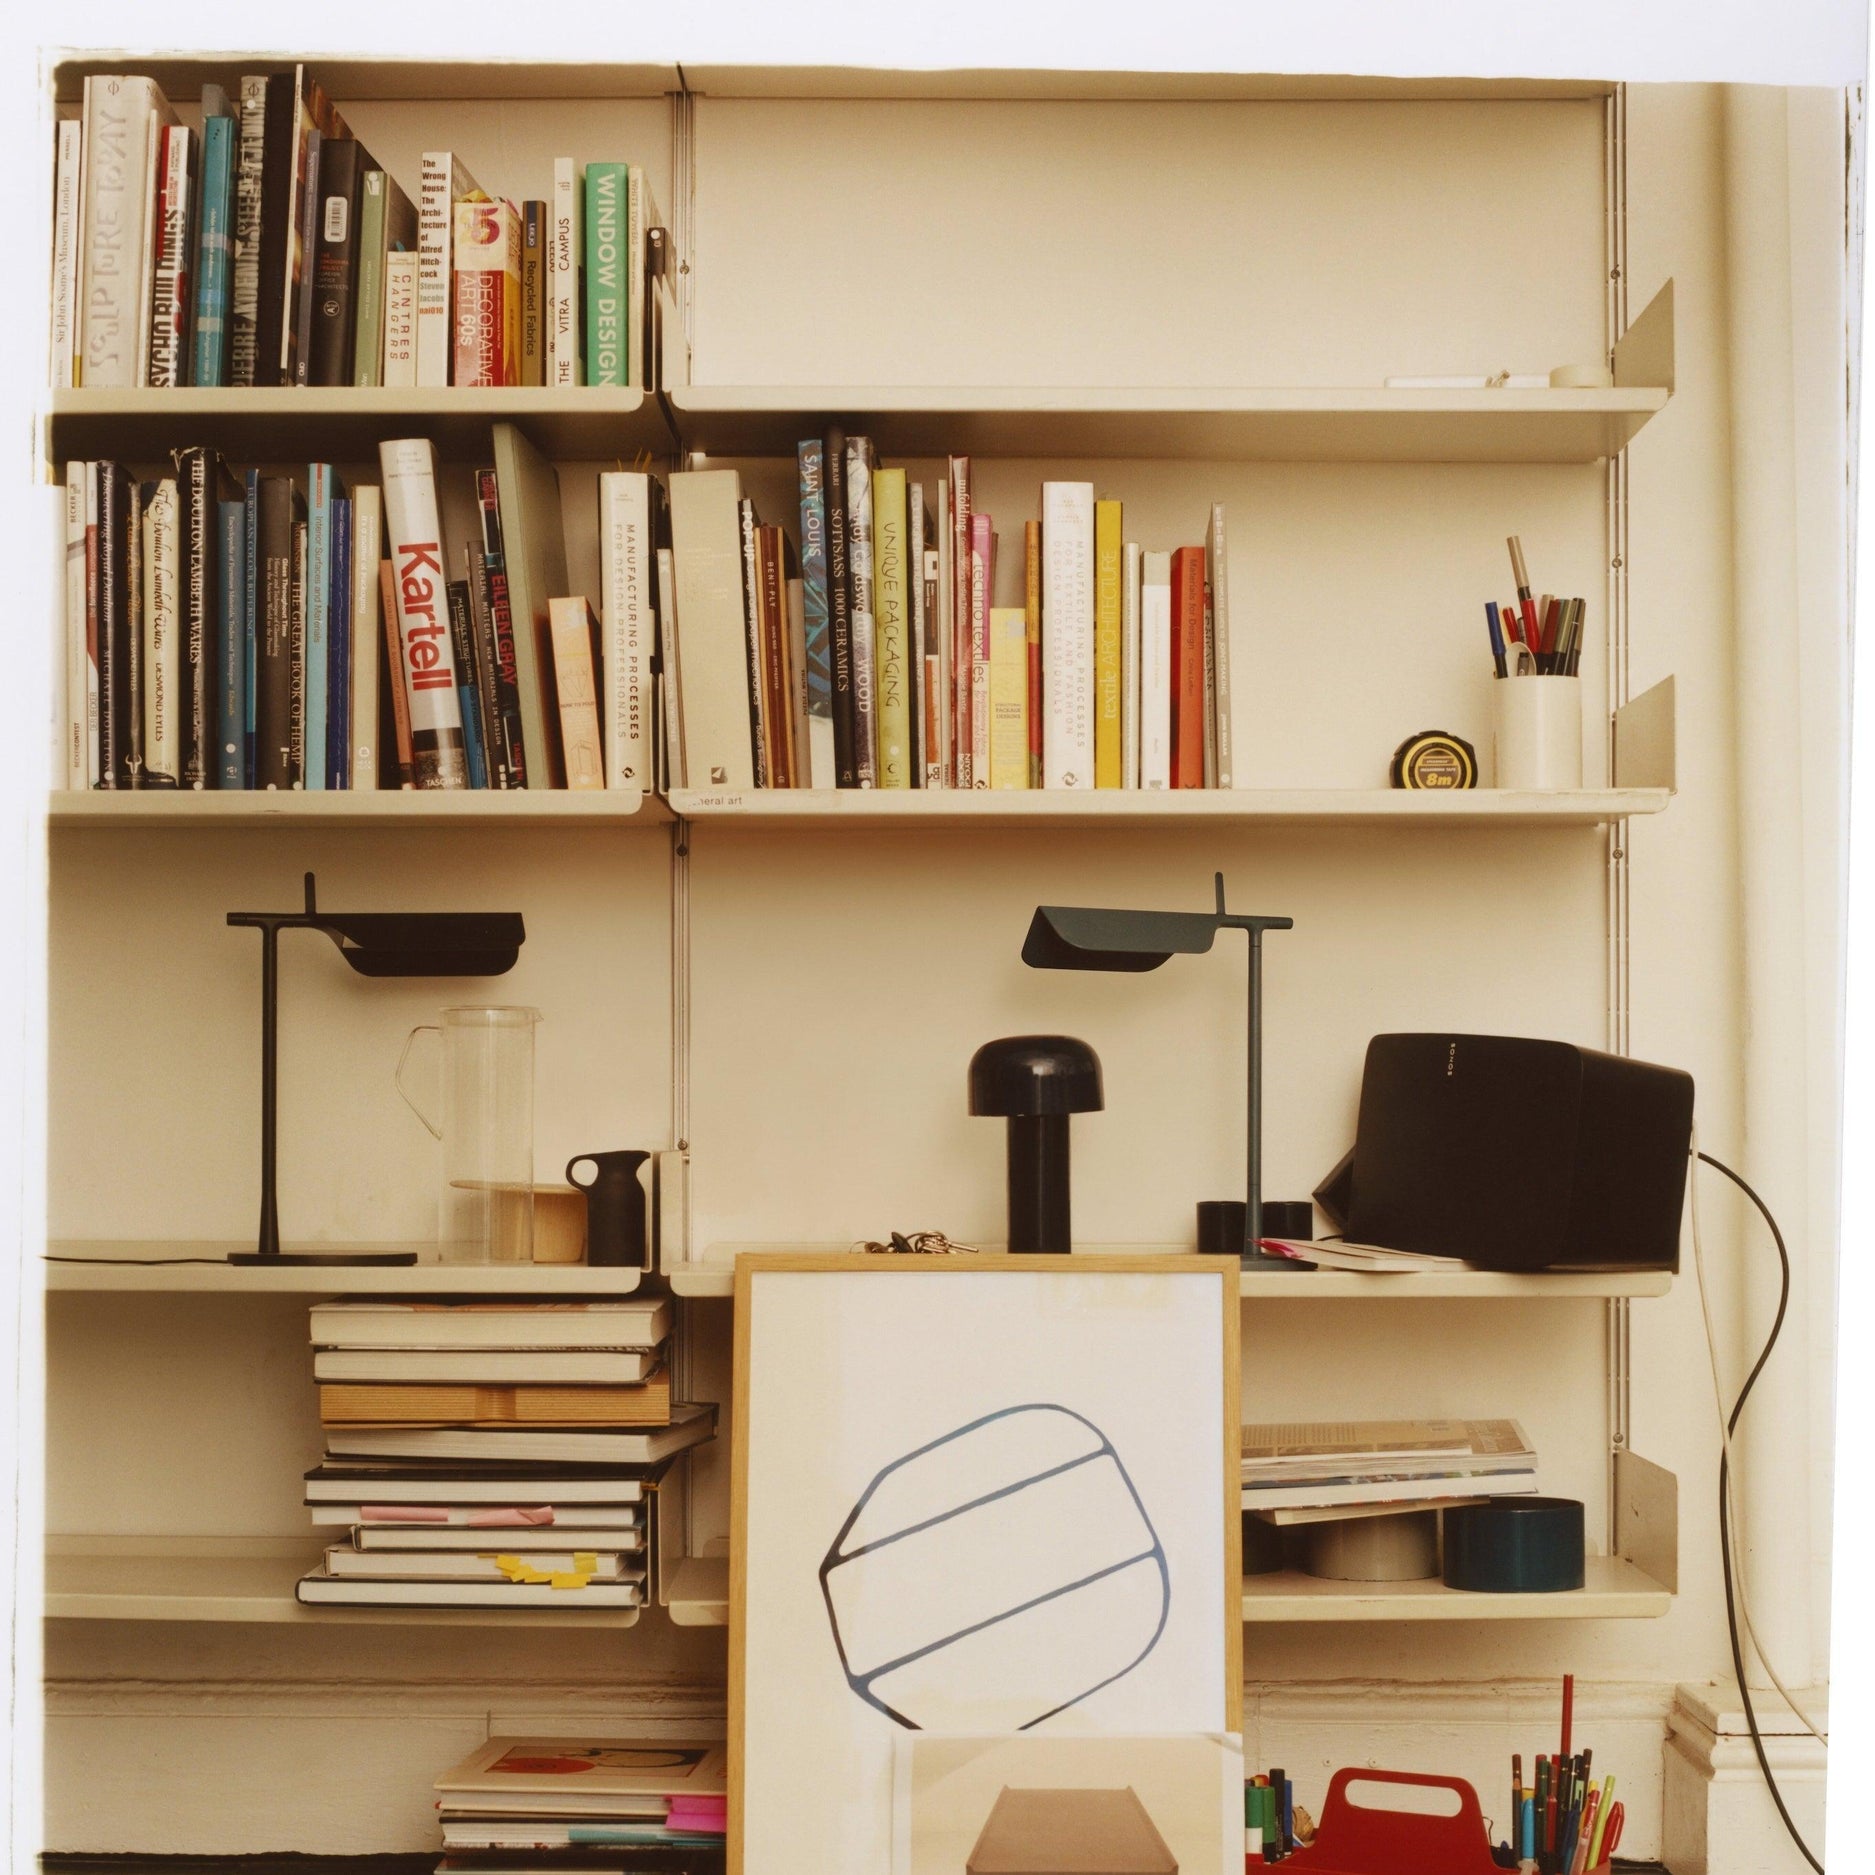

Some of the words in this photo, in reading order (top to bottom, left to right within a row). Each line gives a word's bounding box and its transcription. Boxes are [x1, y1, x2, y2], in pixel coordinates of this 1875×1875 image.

[422, 172, 446, 181] Wrong
[423, 160, 436, 168] The
[61, 177, 70, 216] London
[422, 184, 446, 192] House:
[59, 220, 70, 263] Museum,
[421, 221, 447, 229] tecture
[559, 218, 569, 271] CAMPUS
[597, 173, 616, 288] WINDOW
[57, 265, 67, 302] Soane's
[155, 209, 185, 315] BUILDINGS
[233, 242, 259, 319] KOENIG
[460, 274, 477, 311] ART
[525, 261, 536, 311] Recycled
[56, 305, 67, 330] John
[56, 330, 65, 343] Sir
[390, 275, 400, 360] HANGERS
[400, 275, 411, 360] CINTRES
[460, 315, 477, 347] 60s
[477, 275, 494, 387] DECORATIVE
[526, 316, 536, 356] Fabrics
[559, 297, 569, 334] VITRA
[151, 322, 178, 387] SYCHO
[598, 298, 617, 387] DESIGN
[559, 360, 569, 383] THE
[190, 459, 204, 484] THE
[831, 453, 839, 485] FERRARI
[101, 470, 114, 537] Discovering
[190, 487, 204, 550] DOULTON
[955, 479, 968, 531] unfolding
[89, 532, 97, 572] compendium
[154, 521, 172, 562] Doulton
[315, 516, 323, 544] Interior
[614, 524, 622, 550] FOR
[742, 511, 754, 561] POP-UP
[831, 508, 844, 577] SOTTSASS
[101, 541, 114, 574] Royal
[314, 547, 323, 584] Surfaces
[767, 562, 775, 585] BENT
[881, 523, 899, 590] UNIQUE
[1053, 541, 1061, 591] DESIGN
[1065, 541, 1073, 566] FOR
[103, 575, 114, 622] Doulton
[154, 566, 173, 610] Lambeth
[189, 553, 203, 614] LAMBETH
[291, 581, 302, 607] THE
[314, 587, 322, 602] and
[476, 553, 486, 595] MATERIAL
[482, 601, 491, 639] MATTERS
[614, 559, 623, 610] DESIGN
[626, 524, 637, 648] MANUFACTURING
[768, 590, 776, 607] PLY
[834, 587, 845, 615] 1000
[973, 564, 986, 621] techno
[1077, 541, 1085, 659] MANUFACTURING
[1188, 559, 1198, 600] Materials
[89, 606, 97, 617] the
[313, 605, 323, 642] Materials
[398, 542, 452, 690] Kartell
[491, 575, 511, 635] EILEEN
[1065, 575, 1073, 630] TEXTILE
[1102, 549, 1117, 666] ARCHITECTURE
[1188, 603, 1197, 616] for
[154, 614, 167, 649] Wares
[189, 618, 201, 663] WARES
[291, 611, 302, 655] GREAT
[883, 600, 900, 707] PACKAGING
[1065, 640, 1073, 666] AND
[1187, 619, 1197, 649] Design
[103, 649, 111, 702] MICHAEL
[499, 639, 516, 685] GRAY
[836, 618, 848, 691] CERAMICS
[973, 626, 987, 683] textiles
[1053, 600, 1061, 715] PROFESSIONALS
[155, 663, 164, 711] DESMOND
[291, 661, 302, 696] BOOK
[615, 619, 626, 738] PROFESSIONALS
[629, 656, 639, 740] PROCESSES
[858, 658, 870, 712] WOOD
[1100, 671, 1117, 719] textile
[291, 704, 302, 723] OF
[1065, 675, 1073, 734] FASHION
[1077, 667, 1085, 748] PROCESSES
[104, 710, 112, 770] DOULTON
[155, 715, 163, 741] EYLES
[291, 725, 302, 763] HEMP
[425, 776, 461, 788] TASCHEN
[687, 796, 724, 806] neral
[728, 797, 742, 805] art
[1426, 773, 1452, 786] 8m
[1447, 1043, 1456, 1076] SONOS
